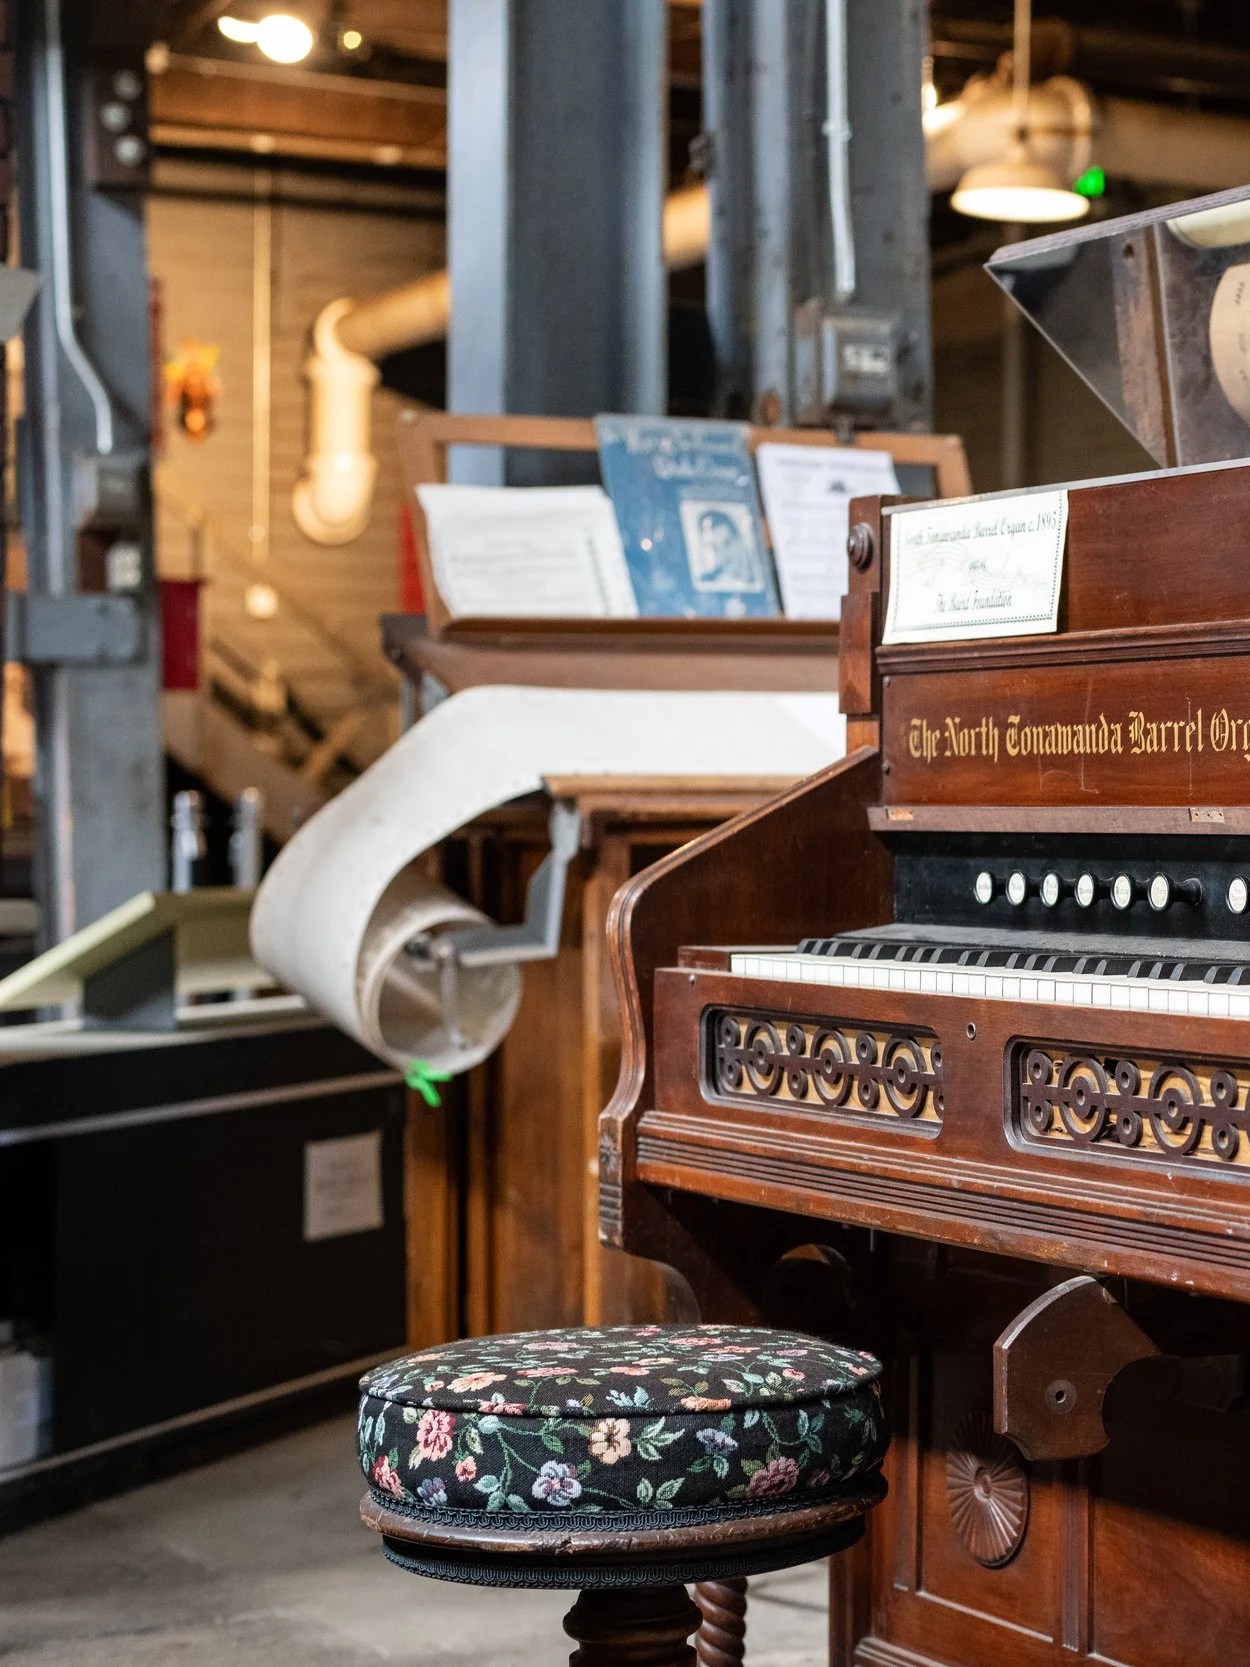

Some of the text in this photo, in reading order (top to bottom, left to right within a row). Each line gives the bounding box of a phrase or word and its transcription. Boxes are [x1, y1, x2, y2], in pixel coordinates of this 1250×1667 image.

[908, 718, 941, 764] The
[943, 716, 999, 763] North
[1005, 713, 1124, 757] Tonawanda
[1128, 709, 1205, 755] Barrel
